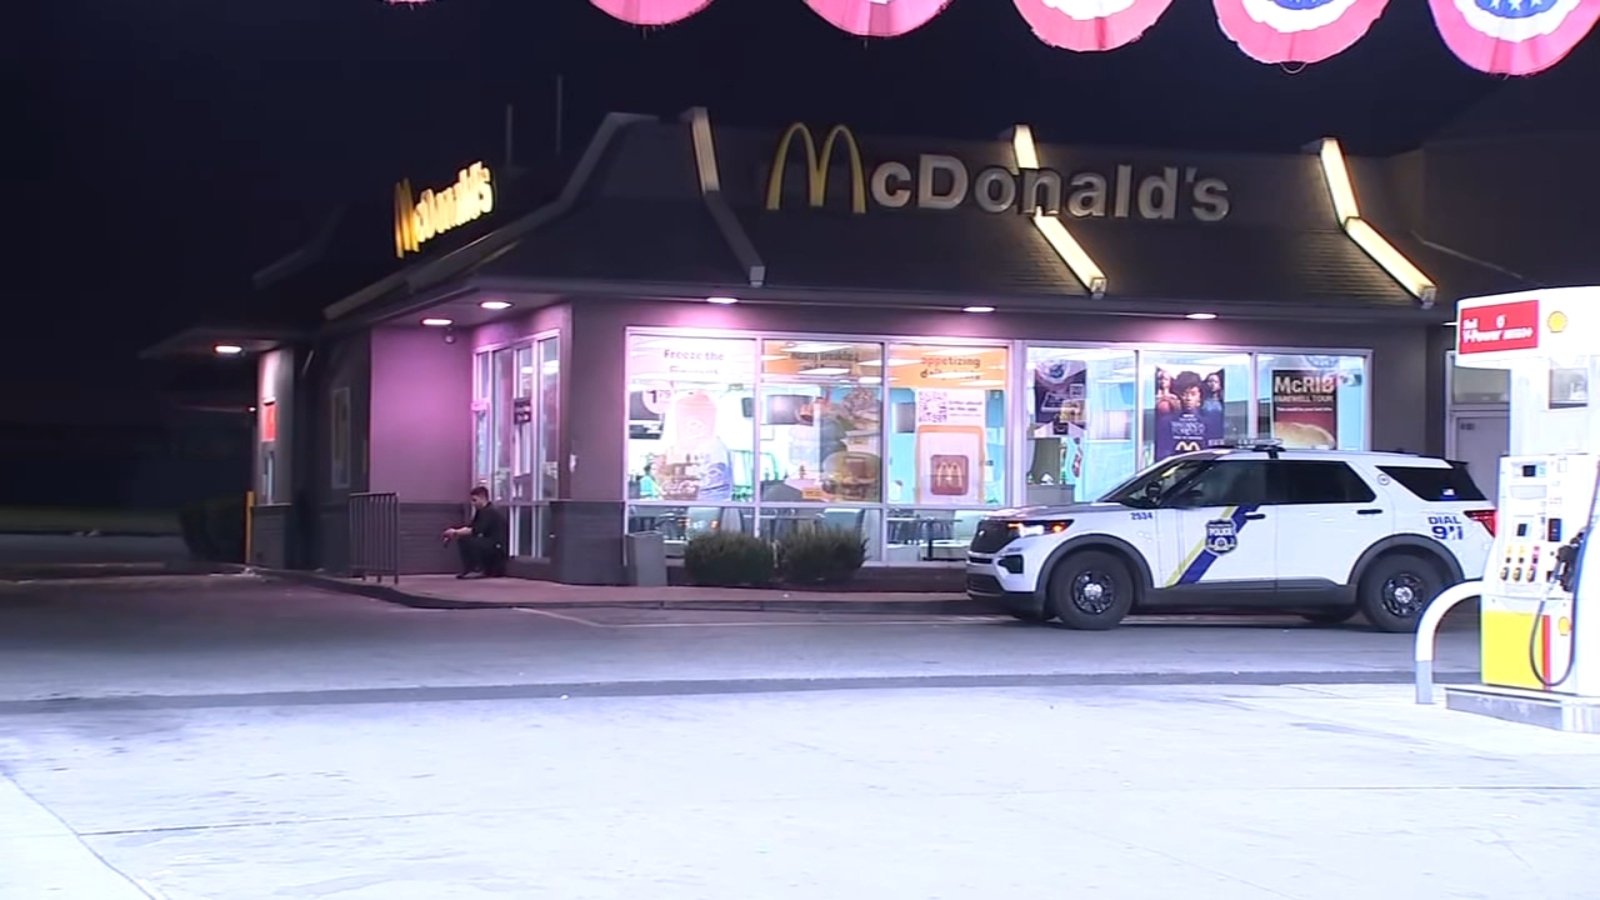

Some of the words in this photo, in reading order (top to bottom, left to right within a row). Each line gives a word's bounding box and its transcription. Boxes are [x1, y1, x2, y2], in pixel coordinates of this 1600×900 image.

[765, 122, 1230, 222] McDonald's
[394, 160, 493, 259] McDonald's
[663, 349, 702, 361] Freeze
[704, 351, 725, 361] the
[1274, 375, 1335, 394] McRIB
[1428, 515, 1462, 525] DIAL
